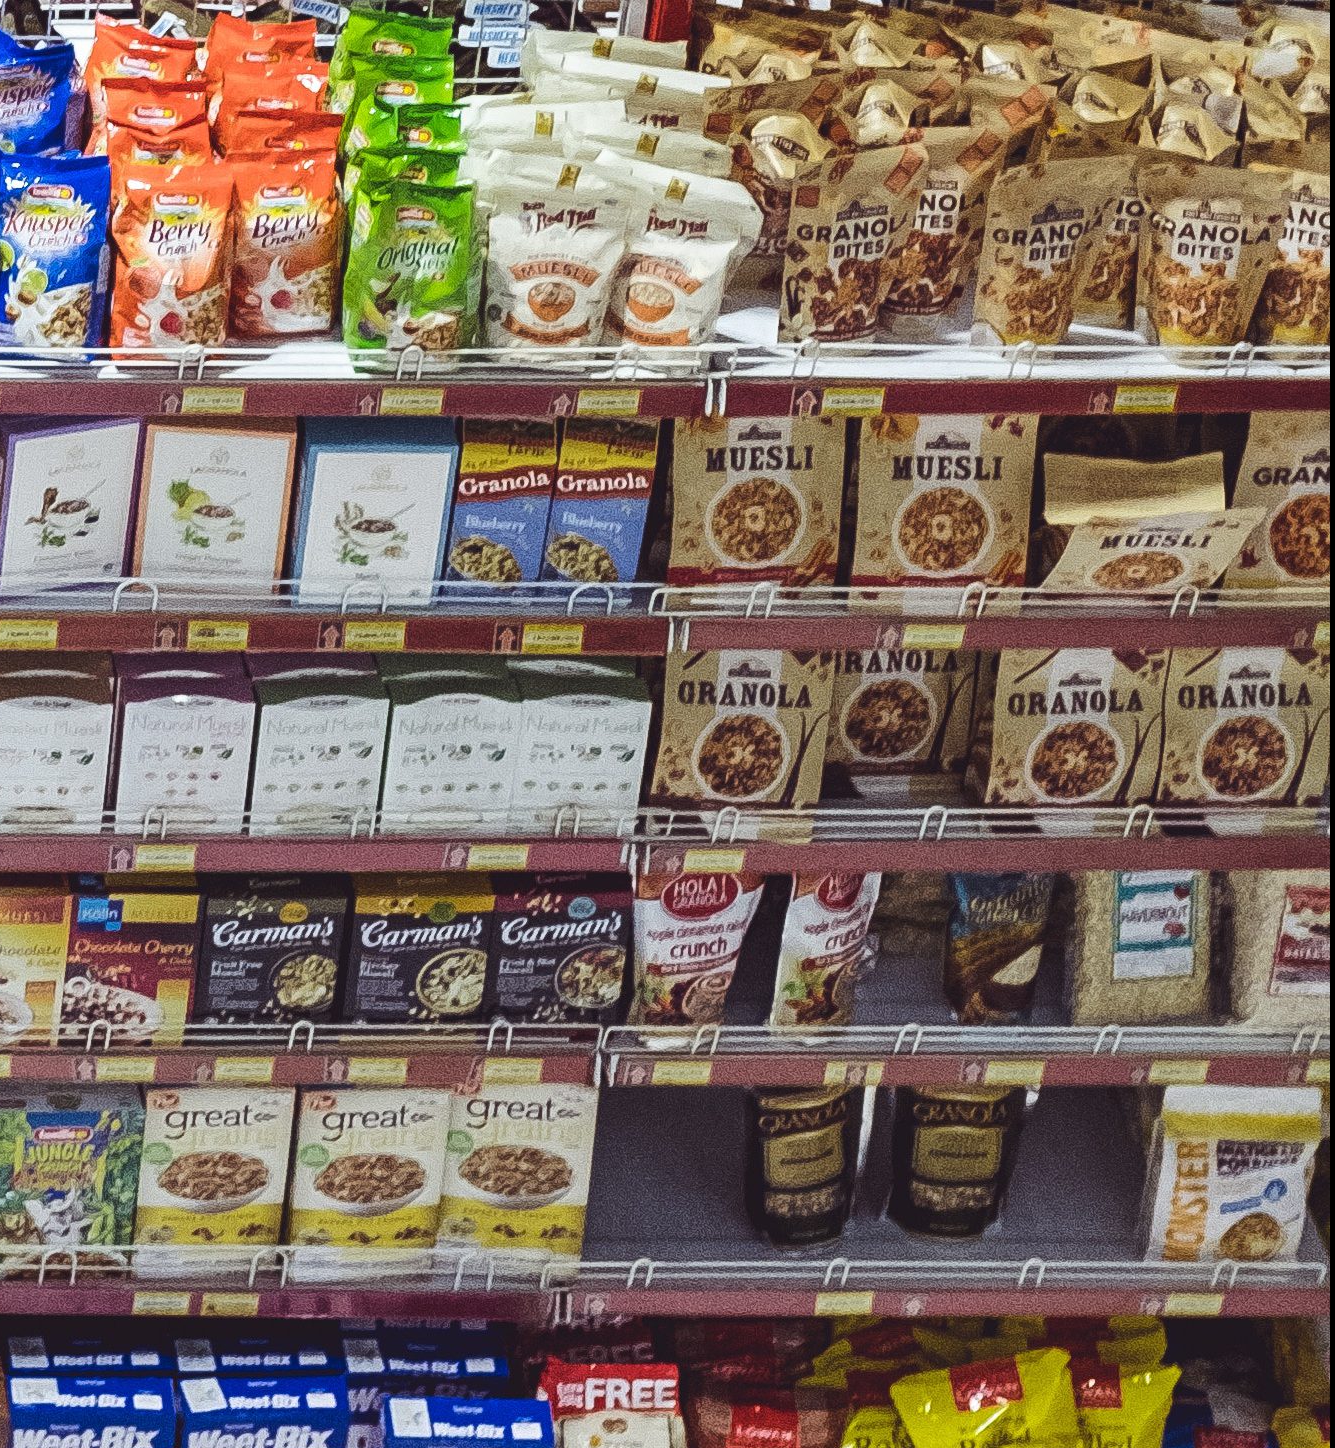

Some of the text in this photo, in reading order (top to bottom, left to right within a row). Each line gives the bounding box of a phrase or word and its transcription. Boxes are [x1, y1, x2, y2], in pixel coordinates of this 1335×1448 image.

[7, 211, 94, 232] Knusper
[149, 219, 211, 248] Berry
[252, 213, 321, 240] Berry
[1149, 213, 1271, 247] GRANOLA
[377, 237, 459, 270] Original
[832, 240, 886, 260] BITES
[1178, 243, 1233, 261] BITES
[706, 445, 813, 472] MUESLI
[892, 456, 1002, 481] MUESLI
[459, 471, 550, 495] Granola
[557, 472, 648, 492] Granola
[1100, 535, 1211, 549] MUESLI
[678, 680, 812, 708] GRANOLA
[1008, 689, 1144, 716] GRANOLA
[1178, 683, 1313, 709] GRANOLA
[212, 917, 333, 949] Carman's
[361, 916, 482, 949] Carman's
[501, 911, 621, 948] Carman's
[144, 940, 194, 960] Cherry
[669, 937, 729, 960] crunch
[165, 1105, 255, 1140] great
[322, 1105, 412, 1142] great
[466, 1097, 554, 1129] great
[585, 1378, 676, 1409] FREE
